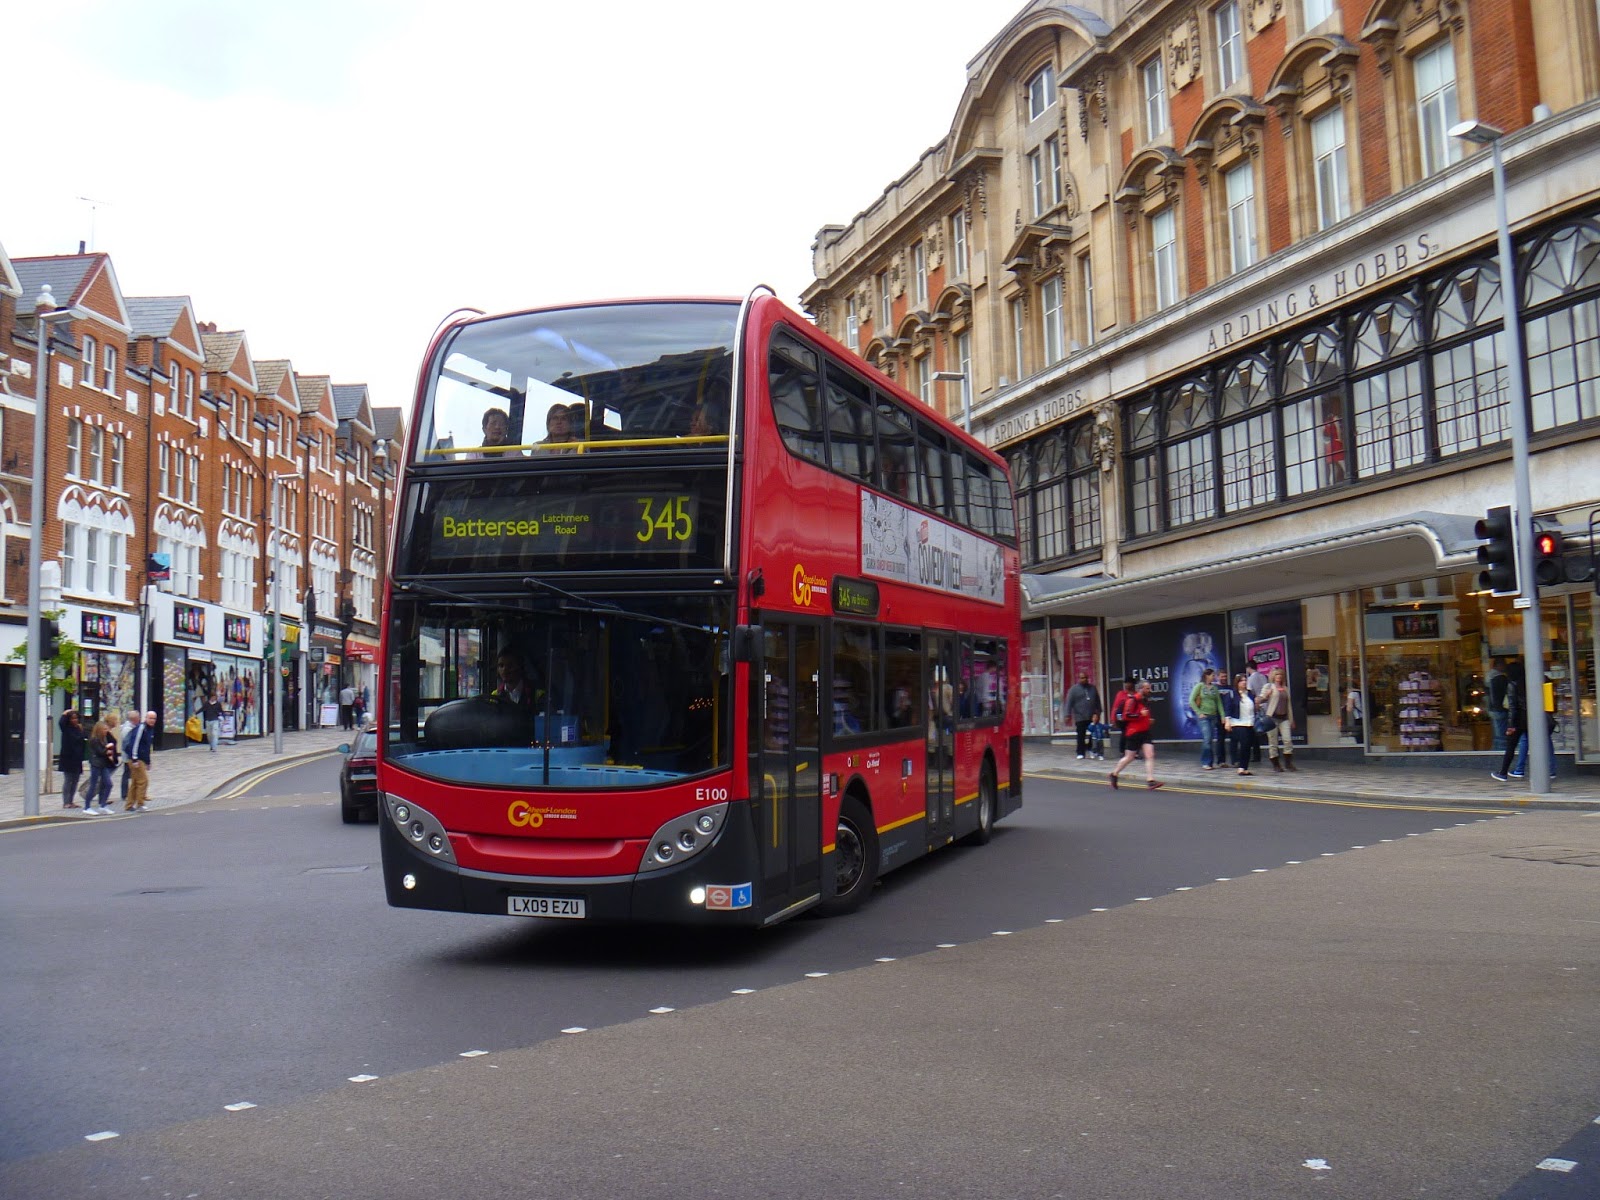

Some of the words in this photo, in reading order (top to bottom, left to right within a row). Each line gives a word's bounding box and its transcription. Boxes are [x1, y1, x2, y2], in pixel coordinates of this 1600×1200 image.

[1207, 293, 1298, 353] ARDING
[1308, 284, 1320, 308] &
[1334, 233, 1430, 298] HOBBS
[994, 413, 1030, 444] ARDING
[1034, 409, 1040, 426] &
[1043, 389, 1082, 423] HOBBS
[443, 516, 539, 538] Battersea
[542, 513, 589, 523] Latchmere
[636, 496, 693, 543] 345
[554, 524, 577, 535] Road
[793, 563, 811, 607] Go
[1132, 666, 1169, 680] FLASH
[695, 788, 728, 801] E100
[507, 800, 543, 828] Go
[513, 899, 549, 913] LX09
[552, 900, 579, 915] EZU
